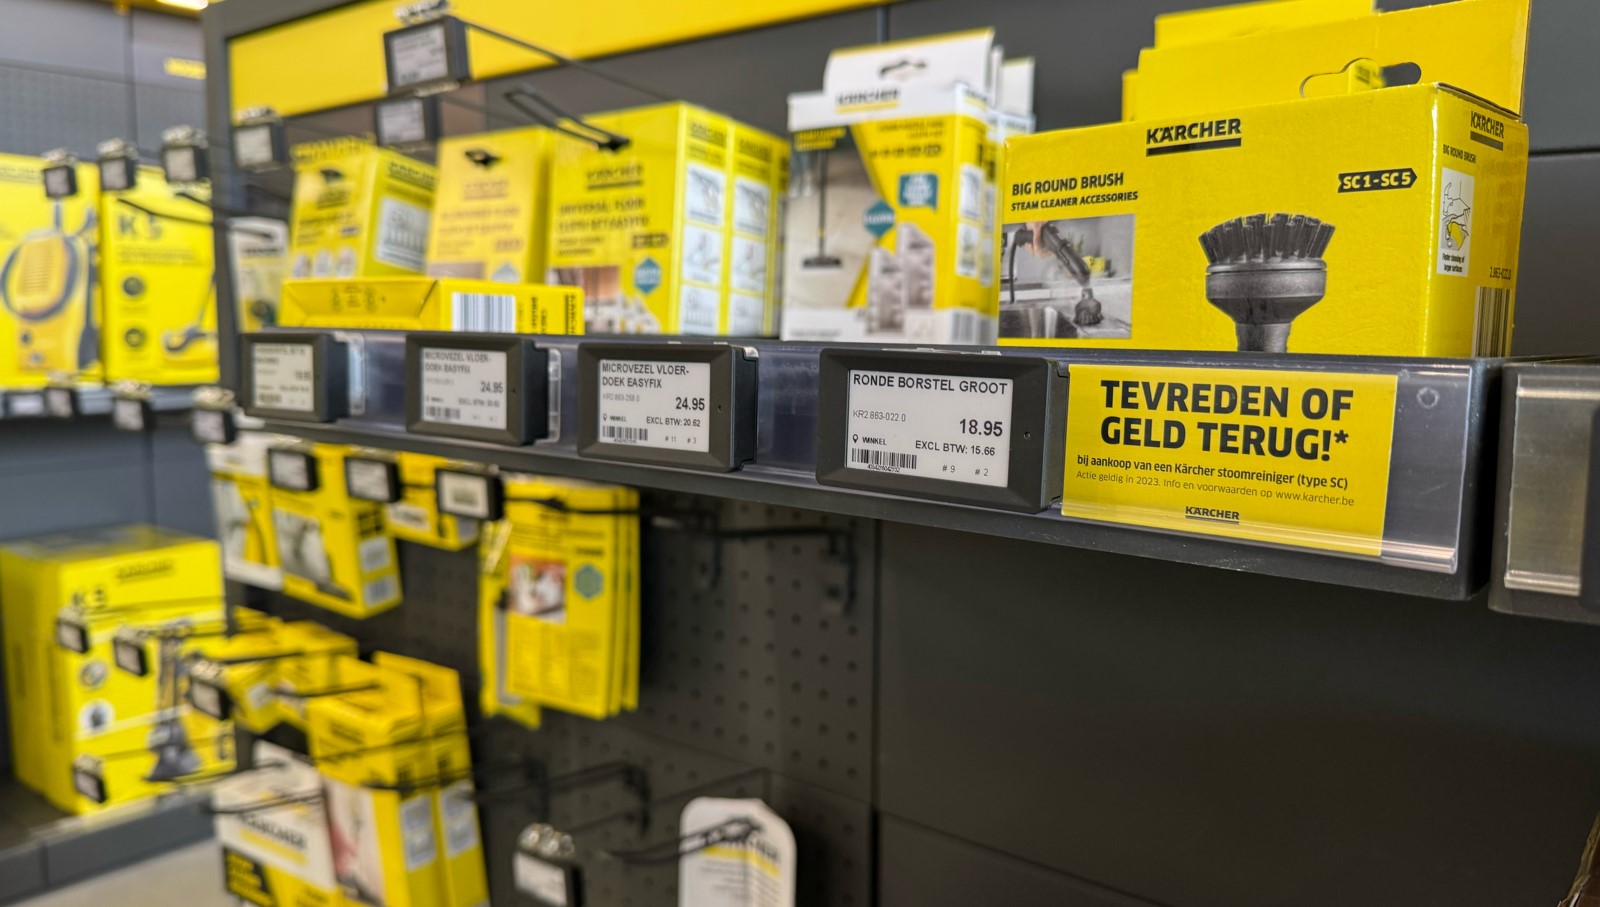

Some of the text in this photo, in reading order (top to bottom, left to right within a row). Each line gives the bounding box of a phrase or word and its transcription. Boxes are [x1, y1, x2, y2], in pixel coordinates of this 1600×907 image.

[1146, 117, 1242, 145] KÄRCHER
[1470, 110, 1505, 139] KÄRCHER
[1442, 144, 1476, 164] BIG ROUND BRUSH
[1011, 172, 1124, 197] BIG ROUND BRUSH
[1343, 175, 1361, 190] SC
[1401, 171, 1411, 185] 5
[1011, 190, 1138, 212] STEAM CLEANER ACCESSORIES
[602, 363, 690, 375] MICROVEZEL VLOER-
[480, 380, 504, 393] 24.95
[602, 376, 662, 389] DOEK EASYFIX
[853, 373, 1008, 395] RONDE BORSTEL GROOT
[675, 396, 706, 411] 24.95
[1100, 380, 1354, 421] TEVREDEN OF
[646, 416, 701, 427] EXCL BTW: 20.62
[959, 418, 1003, 437] 18.95
[862, 436, 887, 446] WINKEL
[1100, 416, 1187, 449] GELD
[915, 440, 996, 456] EXCL BTW: 15.66
[1077, 454, 1349, 490] bij aankoop van een Kärcher stoomreiniger (type SC)
[1076, 470, 1355, 507] Actie geldig in 2023. Info en voorwaarden op www.karcher.be
[1185, 505, 1240, 520] KÄRCHER
